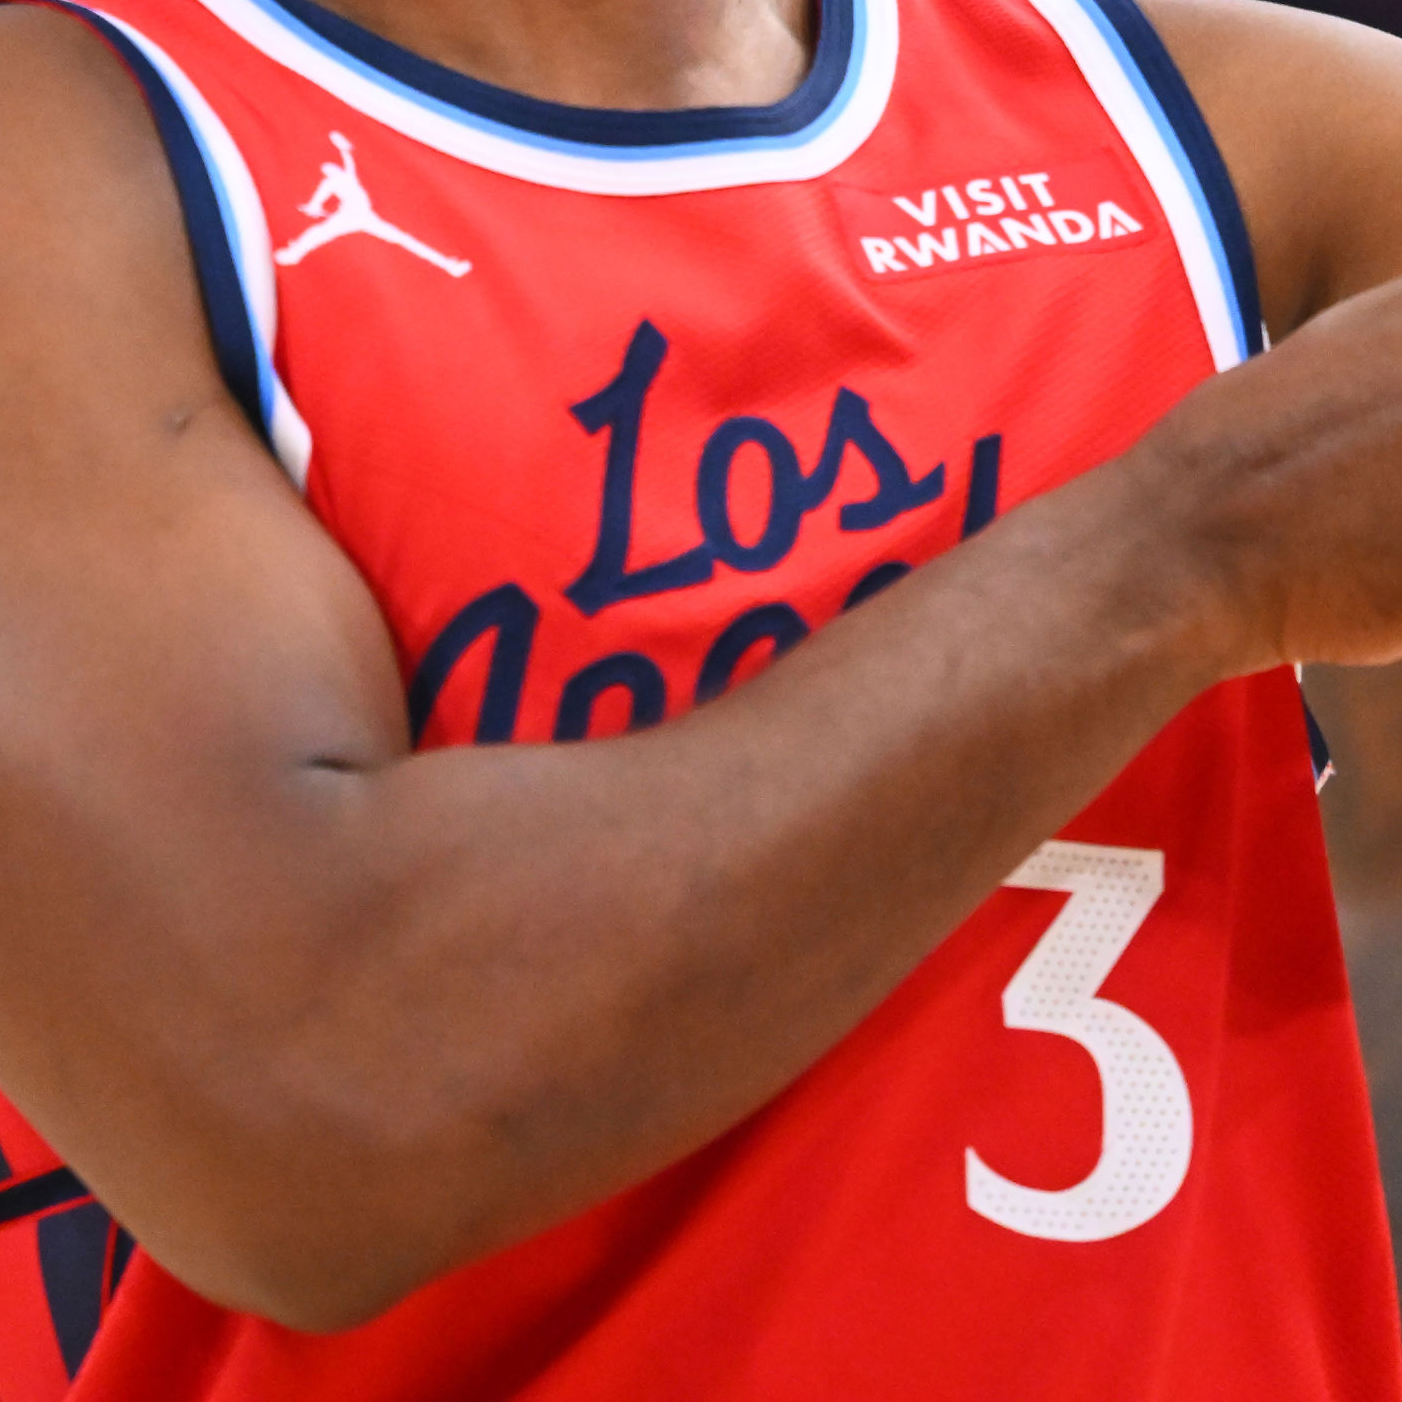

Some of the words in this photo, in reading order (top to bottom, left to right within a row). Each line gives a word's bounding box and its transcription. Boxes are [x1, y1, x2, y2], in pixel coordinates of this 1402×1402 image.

[860, 201, 1144, 274] RWANDA
[892, 172, 1056, 227] VISIT
[563, 318, 946, 619] Los
[964, 839, 1194, 1243] 3
